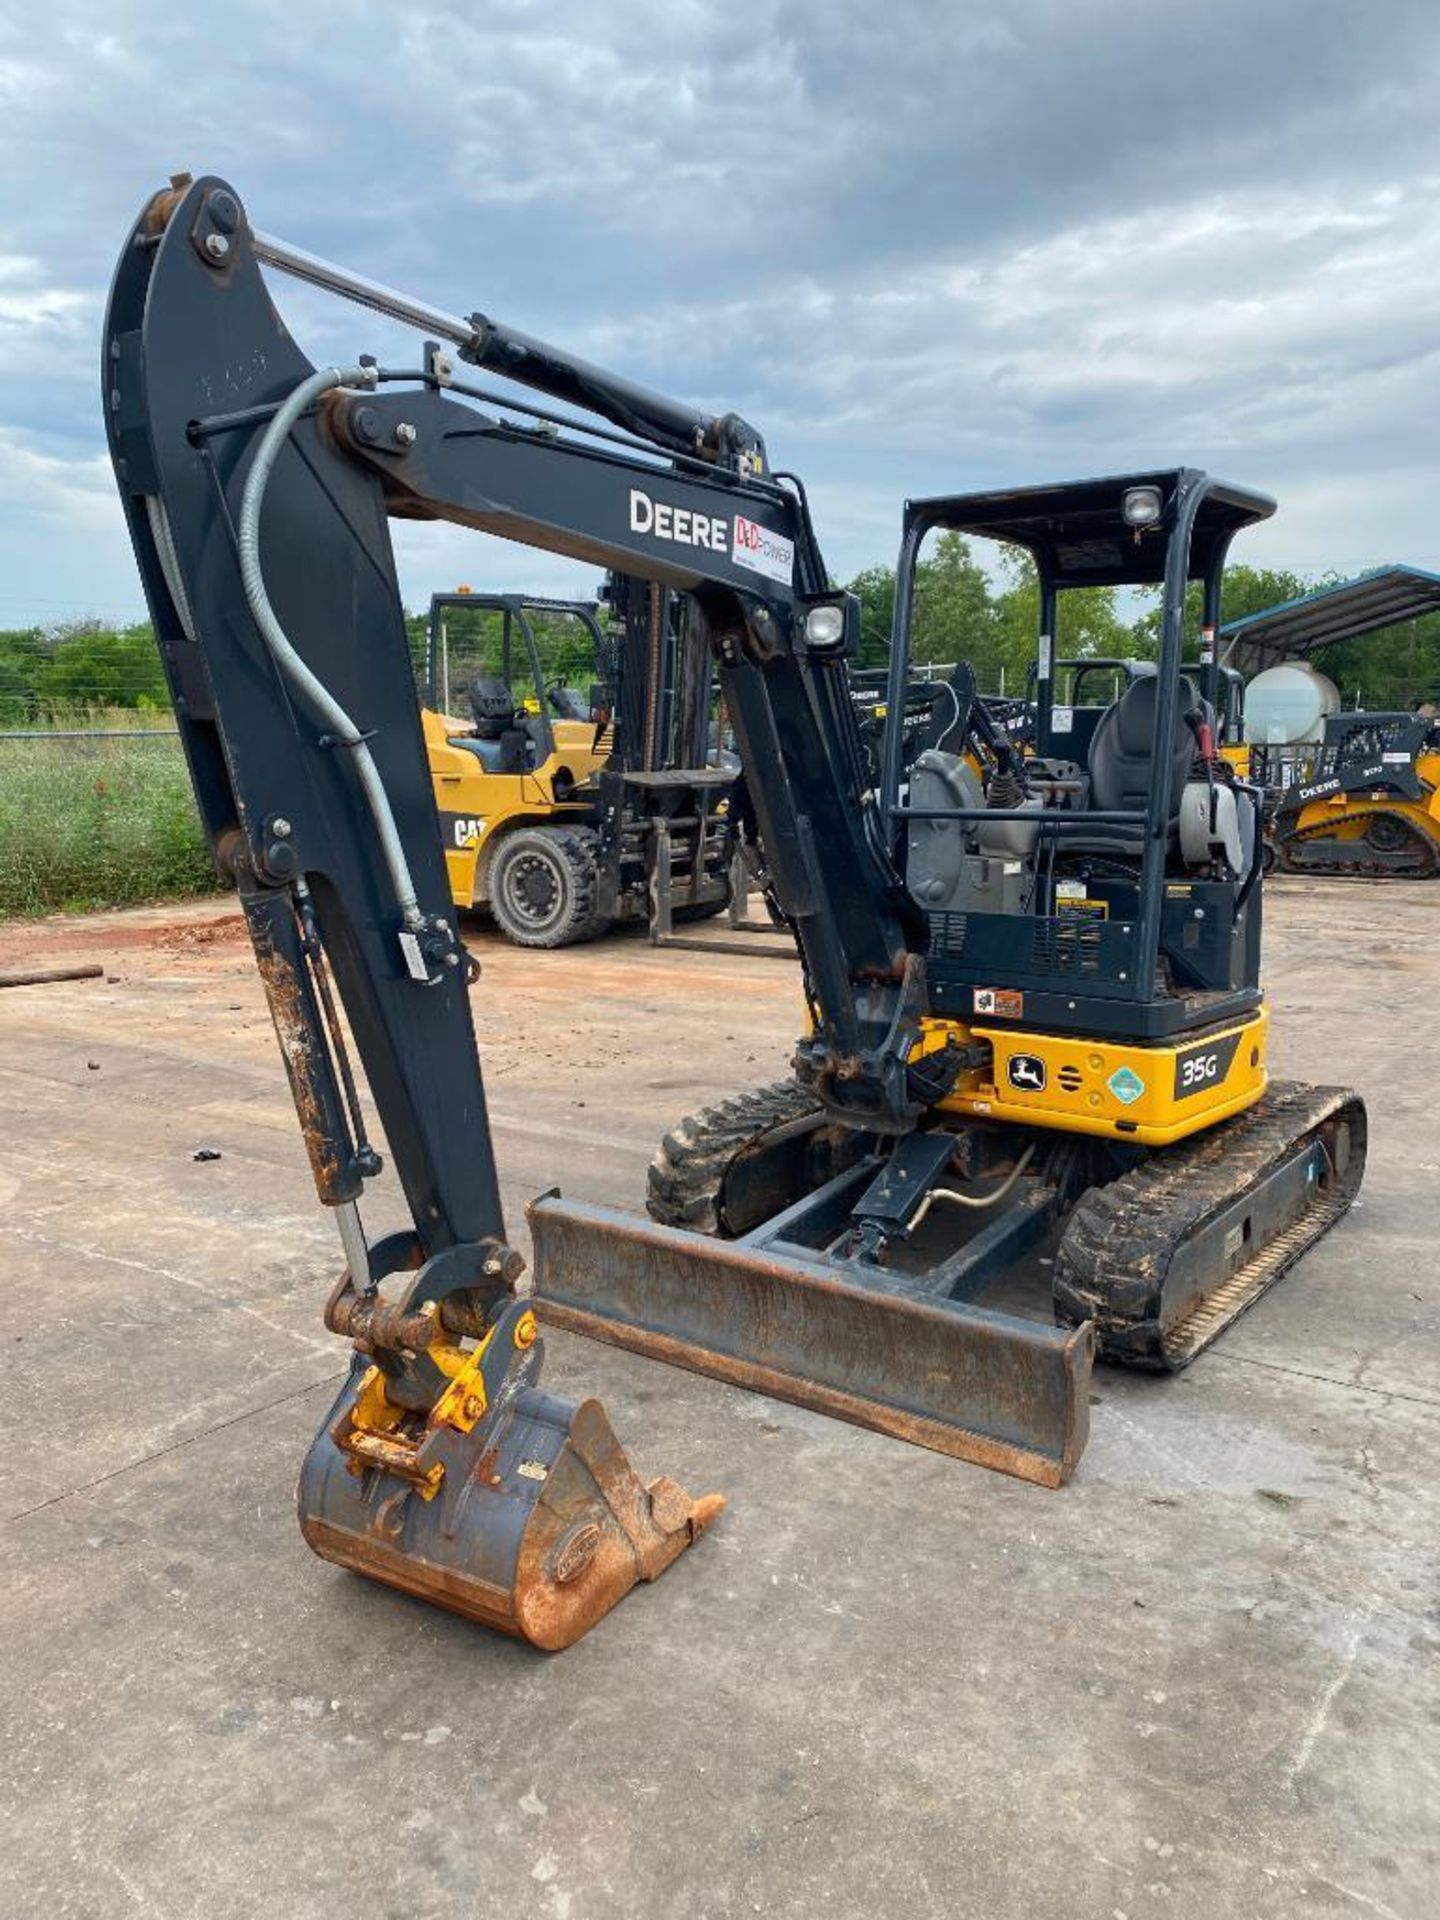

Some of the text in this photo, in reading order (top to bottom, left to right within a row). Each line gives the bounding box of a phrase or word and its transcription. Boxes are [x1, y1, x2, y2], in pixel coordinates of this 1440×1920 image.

[630, 488, 728, 553] DEERE
[1299, 778, 1341, 800] DEERE
[1182, 1054, 1218, 1087] 35G
